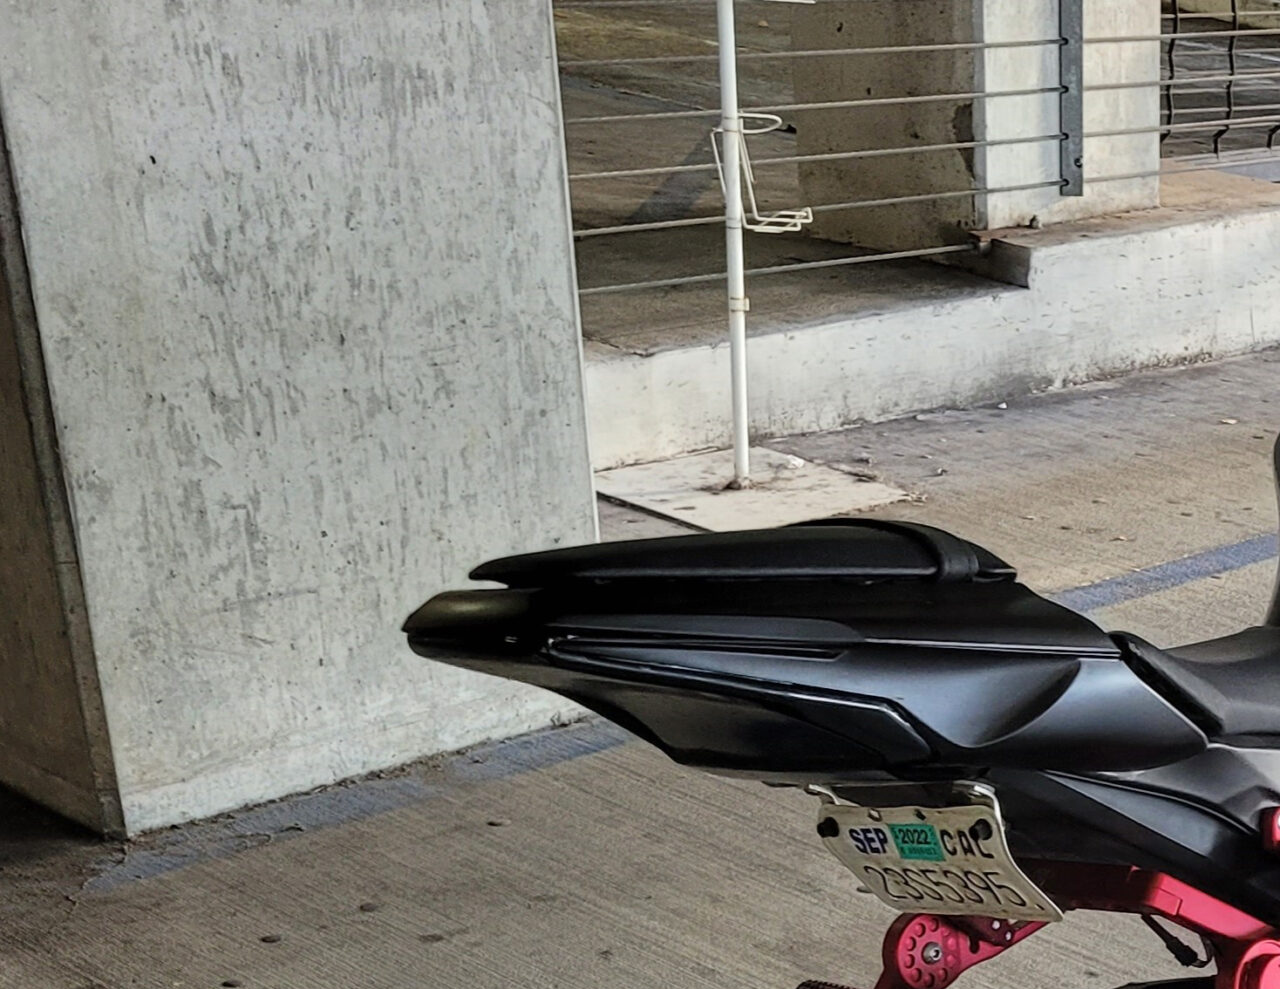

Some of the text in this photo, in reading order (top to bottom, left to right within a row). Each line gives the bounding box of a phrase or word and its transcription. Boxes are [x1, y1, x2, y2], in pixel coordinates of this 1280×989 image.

[849, 827, 888, 855] SEP
[898, 828, 931, 845] 2022
[940, 829, 995, 859] CAL
[863, 865, 1027, 907] 23S5395
